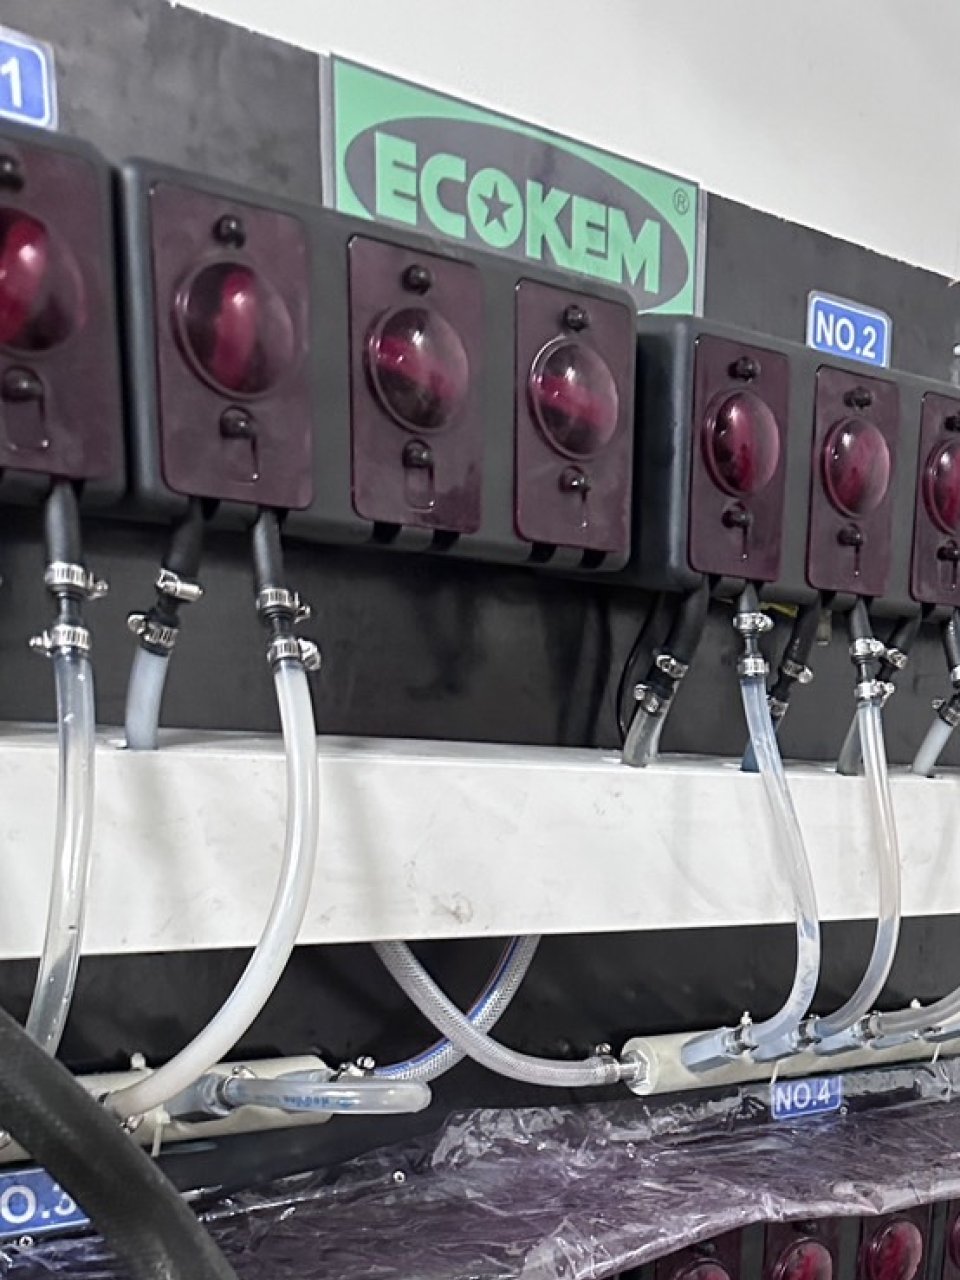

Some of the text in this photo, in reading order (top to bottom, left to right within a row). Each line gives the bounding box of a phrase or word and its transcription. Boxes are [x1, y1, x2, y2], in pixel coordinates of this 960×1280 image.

[375, 130, 661, 294] ECOKEM
[815, 309, 877, 359] NO.2
[775, 1079, 831, 1113] NO.4
